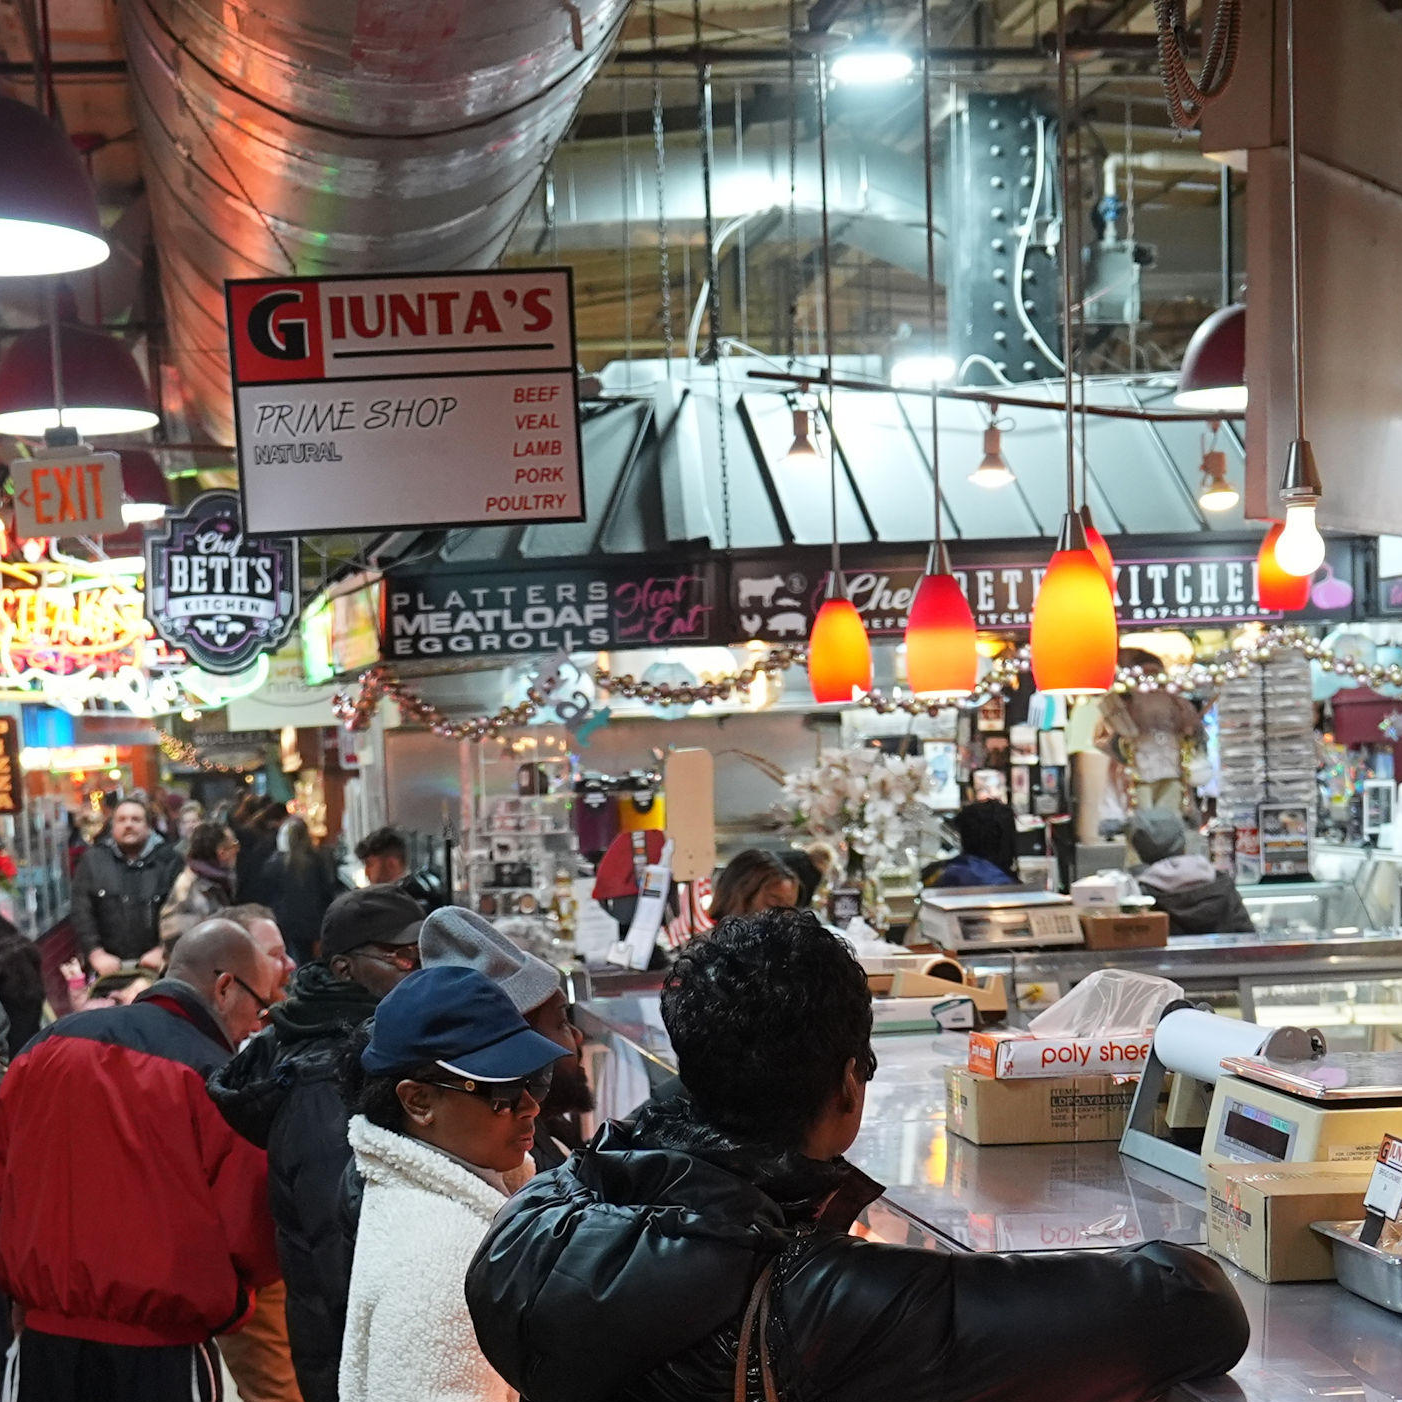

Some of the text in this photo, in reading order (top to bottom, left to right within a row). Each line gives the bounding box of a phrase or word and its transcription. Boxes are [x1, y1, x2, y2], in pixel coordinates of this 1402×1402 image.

[247, 288, 554, 361] GIUNTA'S
[513, 386, 561, 403] BEEF
[255, 396, 458, 437] PRIME SHOP
[515, 414, 561, 431] VEAL
[254, 442, 343, 465] NATURAL
[513, 440, 563, 458] LAMB
[514, 467, 564, 485] PORK
[31, 464, 105, 524] EXIT
[485, 493, 567, 513] POULTRY
[195, 531, 244, 558] Chef
[170, 554, 273, 594] BETH'S
[184, 601, 261, 614] KITCHEN
[391, 581, 608, 612] PLATTERS
[393, 603, 609, 636] MEATLOAF
[1041, 1041, 1149, 1068] poly shee
